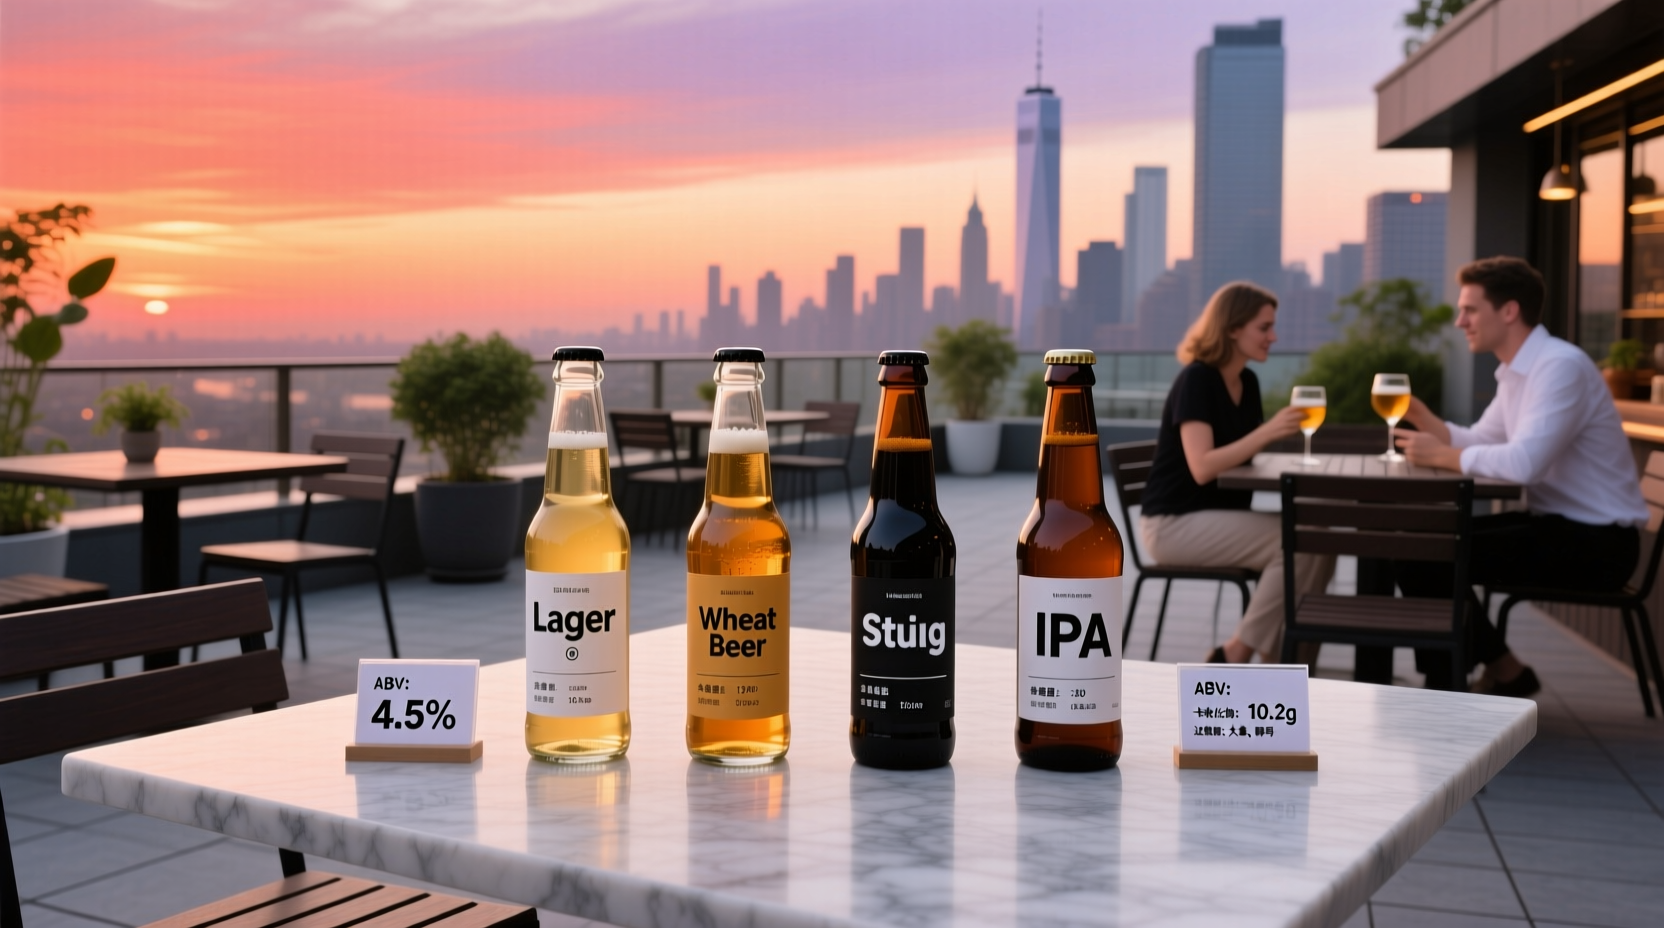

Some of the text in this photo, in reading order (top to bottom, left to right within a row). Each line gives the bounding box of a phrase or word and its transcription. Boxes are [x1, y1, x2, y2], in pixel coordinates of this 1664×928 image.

[533, 601, 616, 642] Lager
[699, 606, 777, 631] Wheat
[709, 633, 767, 658] Beer
[1036, 612, 1112, 658] IPA
[374, 676, 410, 690] ABV:
[1194, 681, 1231, 696] ABV:
[371, 699, 456, 730] 4.5%
[1248, 703, 1297, 725] 10.2g
